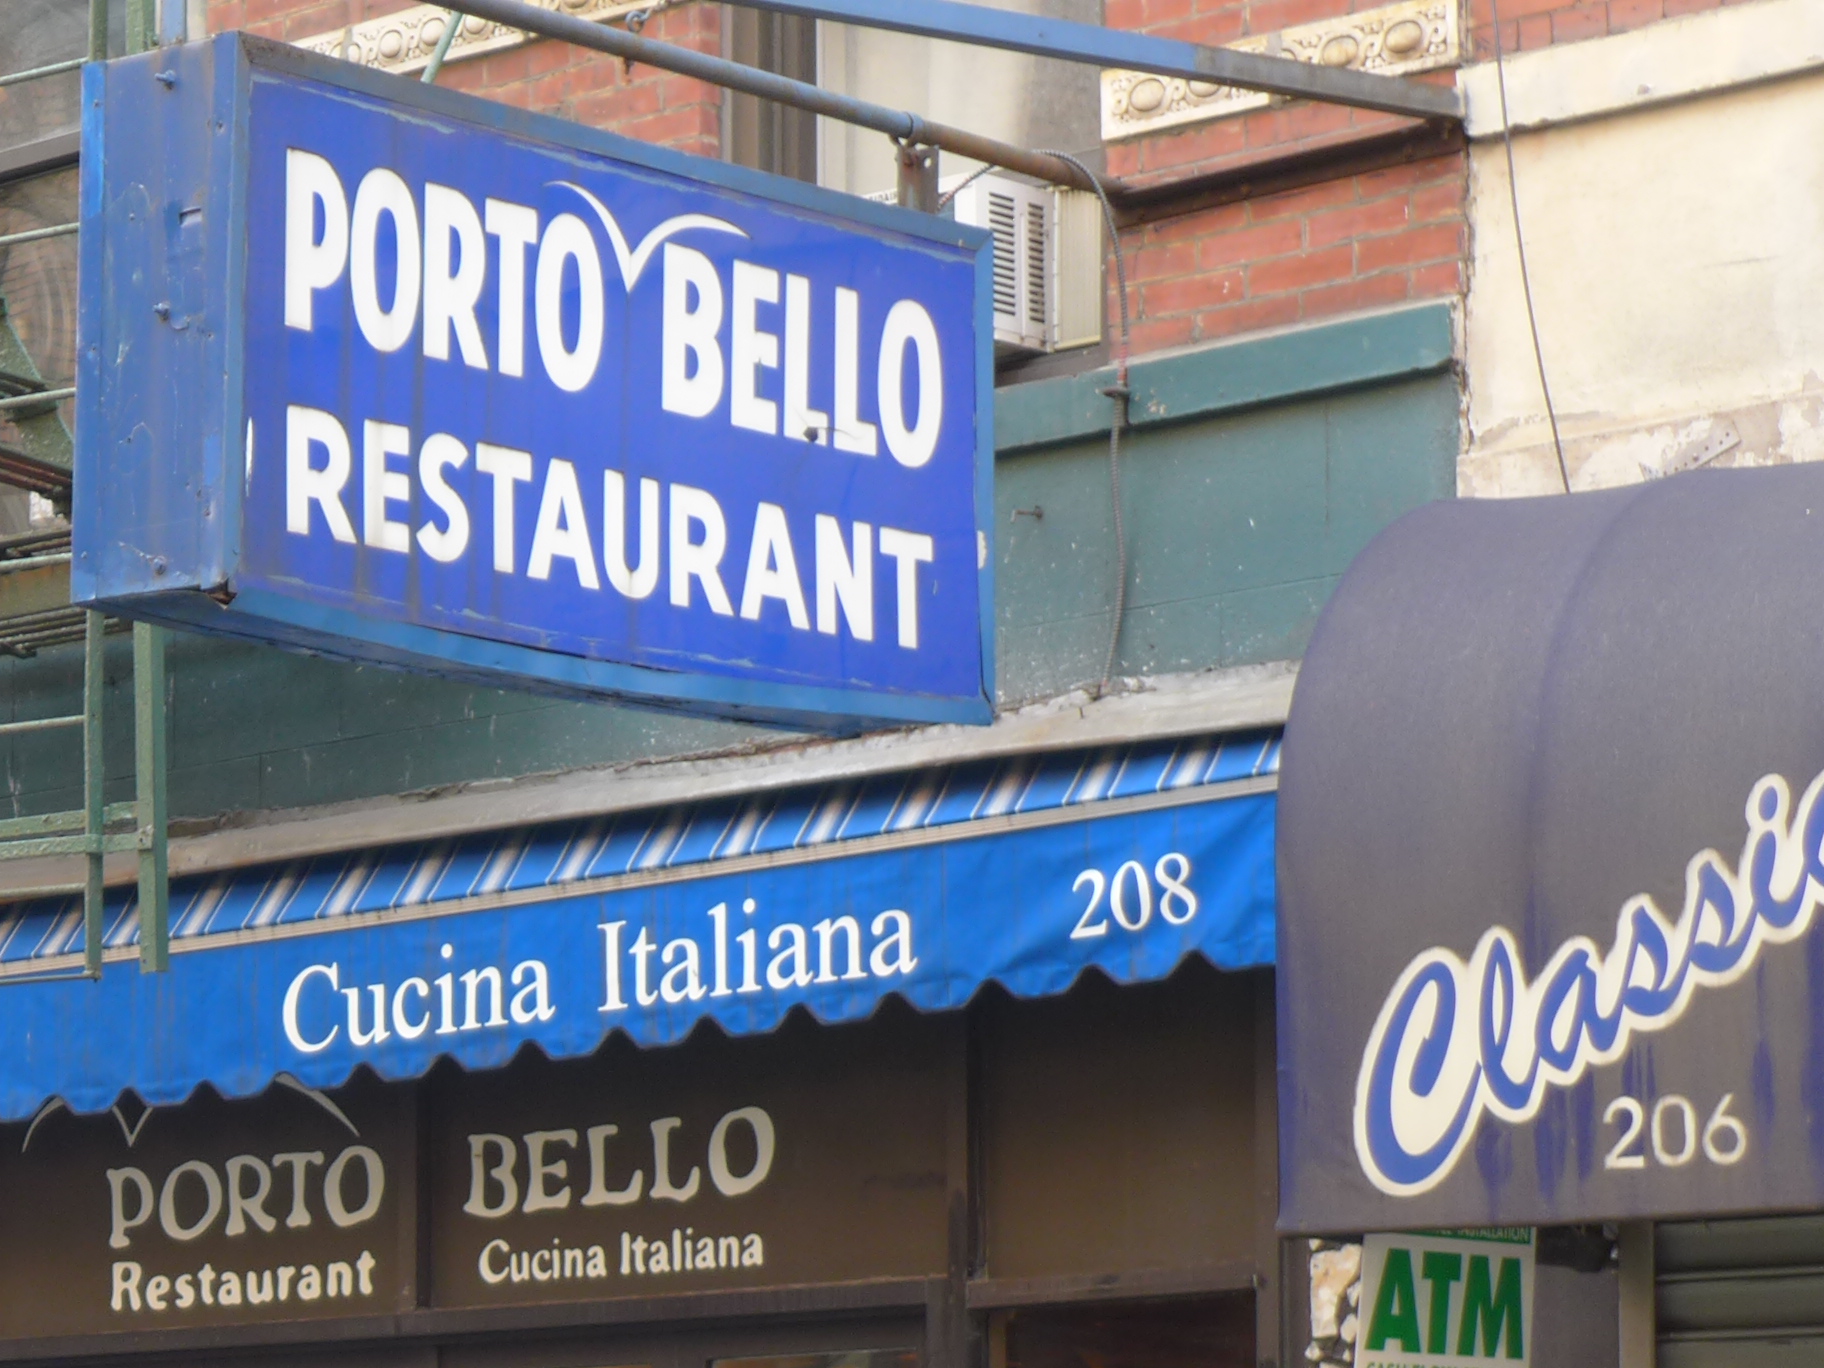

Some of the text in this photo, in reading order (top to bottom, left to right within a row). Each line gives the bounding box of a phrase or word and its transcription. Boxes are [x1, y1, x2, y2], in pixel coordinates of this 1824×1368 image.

[285, 147, 943, 469] PORTO BELLO
[285, 404, 934, 650] RESTAURANT
[1069, 852, 1198, 940] 208
[282, 897, 919, 1053] Cucina Italiana
[107, 1105, 776, 1248] PORTO BELLO
[1603, 1093, 1747, 1170] 206
[110, 1250, 376, 1312] Restaurant
[478, 1226, 763, 1286] Cucina Italiana
[1365, 1247, 1523, 1360] ATM
